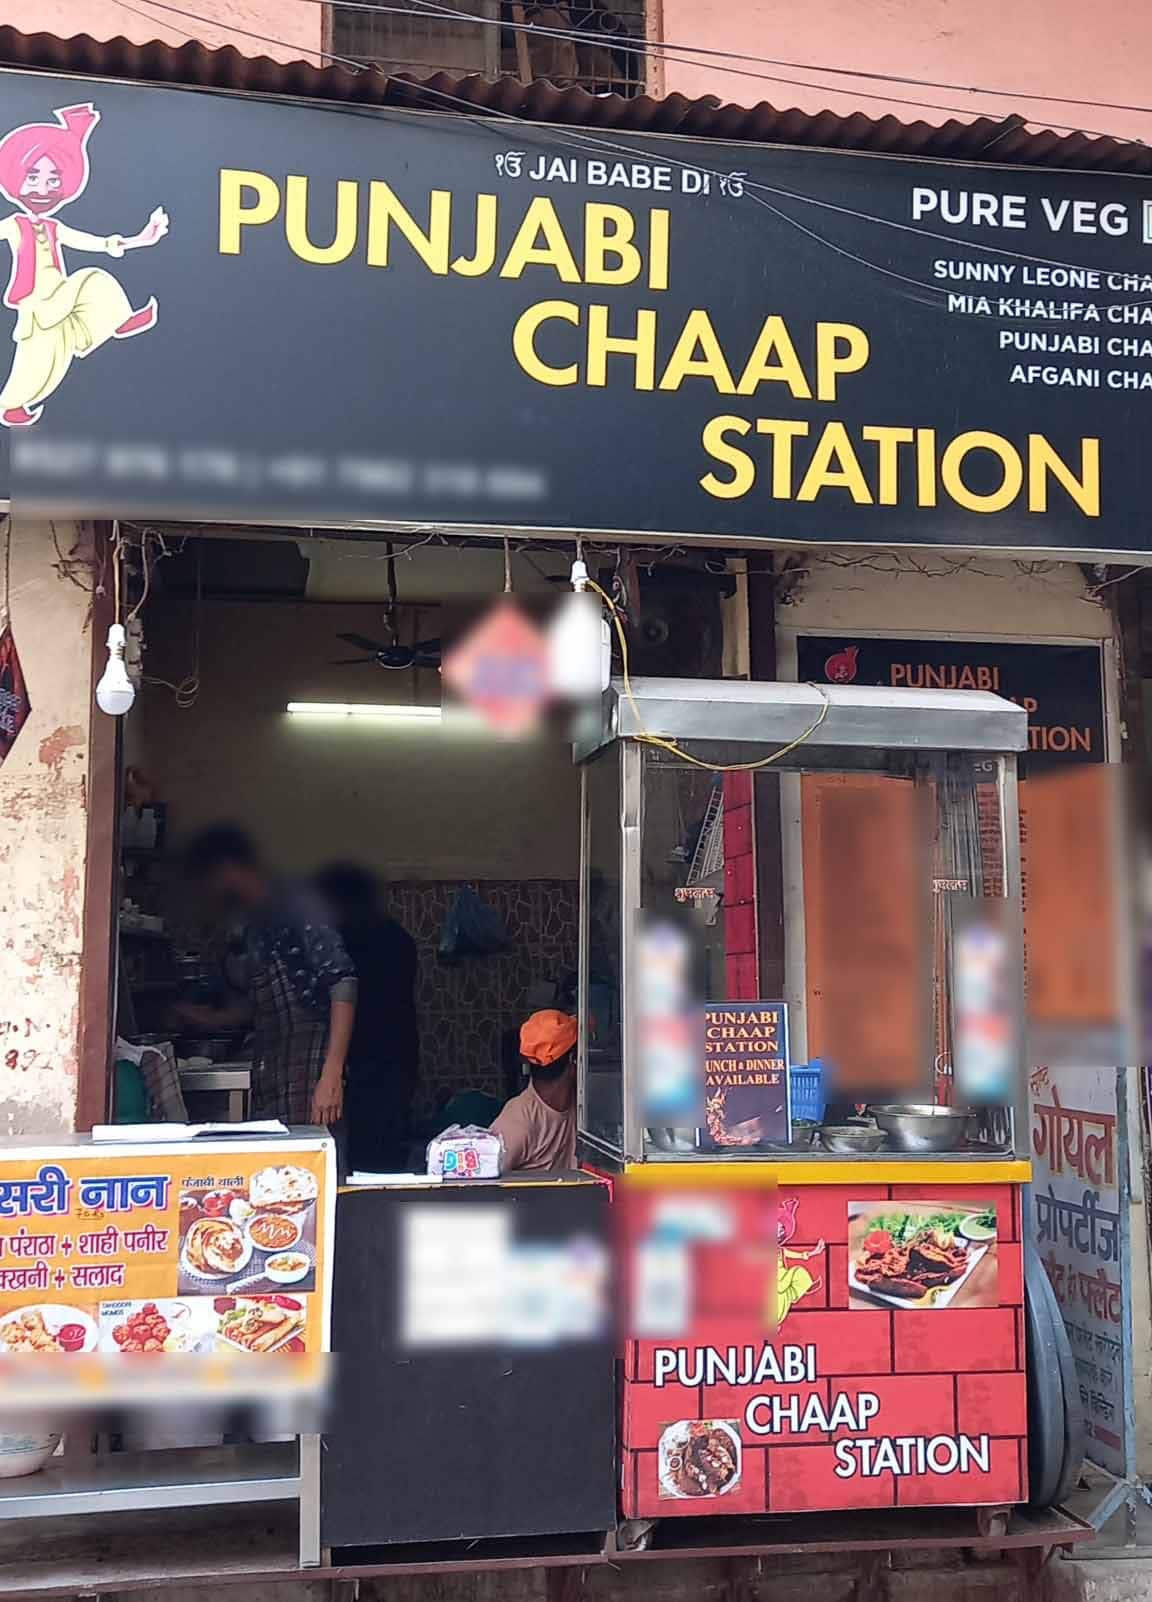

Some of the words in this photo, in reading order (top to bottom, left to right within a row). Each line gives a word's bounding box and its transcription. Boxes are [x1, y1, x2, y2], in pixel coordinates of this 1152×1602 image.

[529, 157, 577, 183] JAI
[587, 161, 672, 190] BABE
[681, 169, 710, 194] DI
[912, 187, 1027, 229] PURE
[1041, 198, 1129, 236] VEG
[218, 168, 670, 291] PUNJABI
[934, 260, 1015, 283] SUNNY
[1023, 266, 1100, 289] LEONE
[948, 294, 992, 315] MIA
[1000, 298, 1100, 322] KHALIFA
[512, 299, 870, 402] CHAAP
[1000, 331, 1100, 355] PUNJABI
[1009, 365, 1100, 388] AFGANI
[699, 415, 1101, 518] STATION
[890, 663, 999, 690] PUNJABI
[1029, 726, 1091, 751] TION
[705, 1041, 778, 1053] STATION
[707, 1027, 775, 1038] CHAAP
[705, 1060, 737, 1072] UNCH
[746, 1059, 785, 1071] DINNER
[706, 1074, 779, 1086] AVAILABLE
[1033, 1084, 1116, 1185] गोयल
[81, 1176, 168, 1209] नान
[79, 1226, 118, 1254] शाही
[124, 1224, 168, 1251] पनीर
[72, 1265, 124, 1287] सलाद
[654, 1345, 817, 1386] PUNJABI
[746, 1394, 880, 1434] CHAAP
[835, 1436, 990, 1477] STATION
